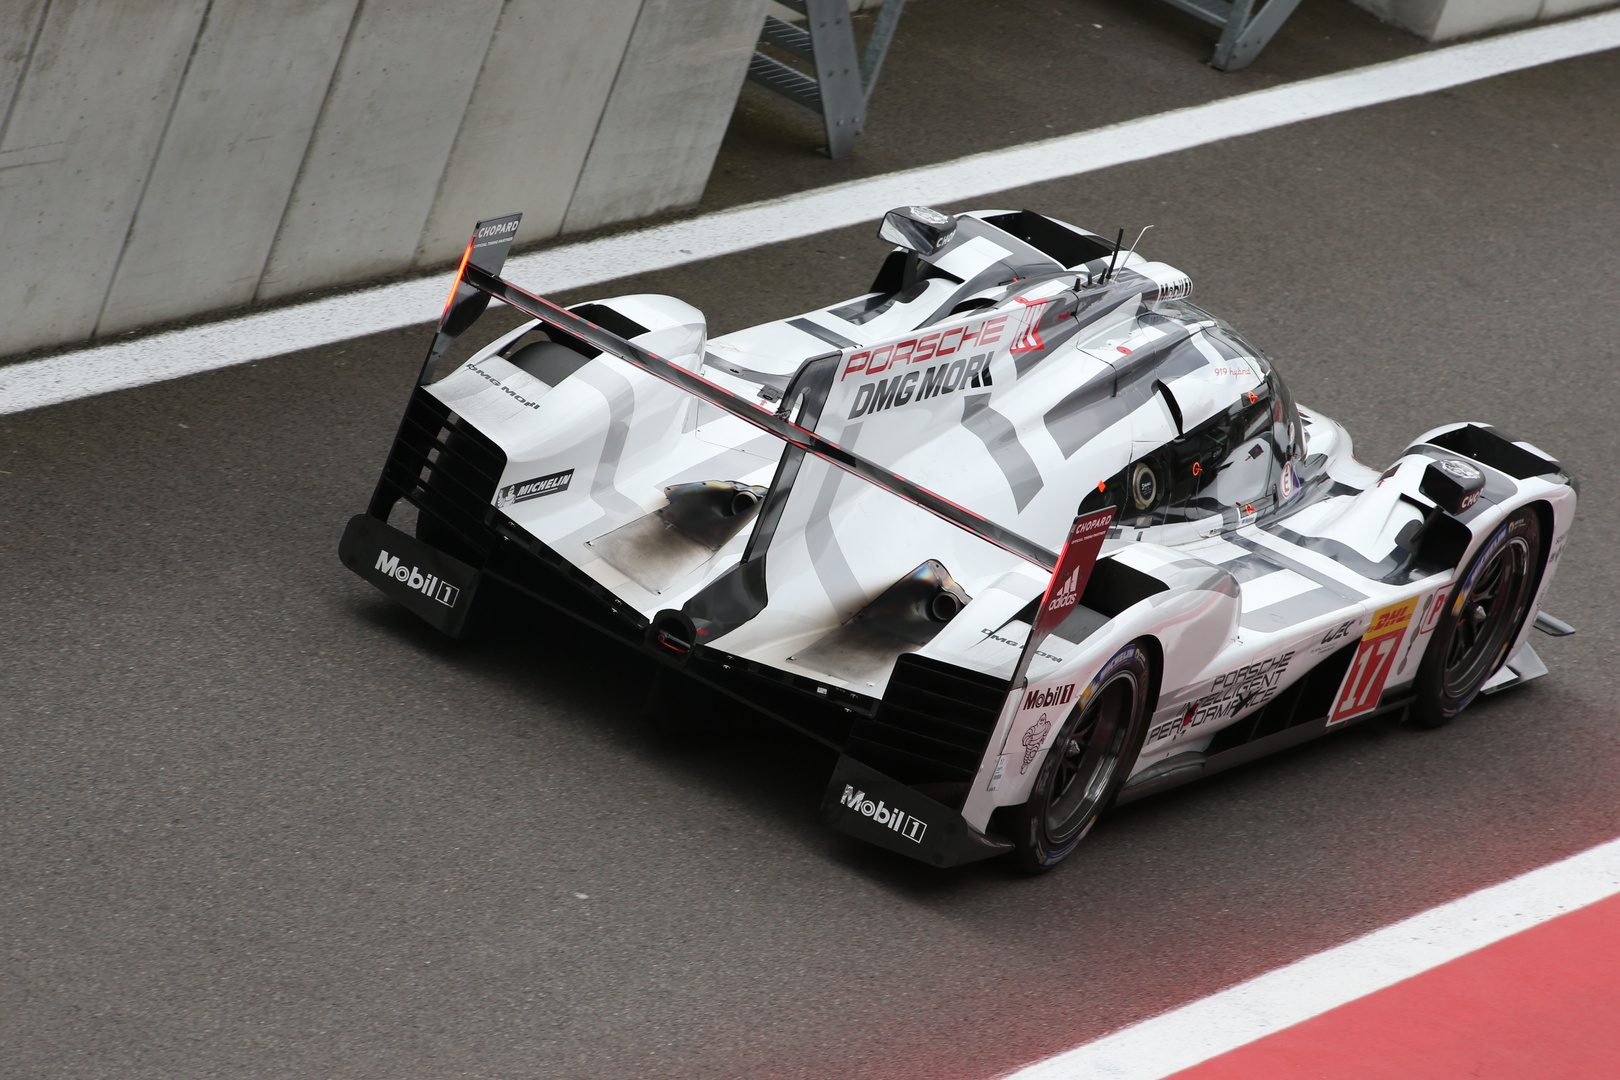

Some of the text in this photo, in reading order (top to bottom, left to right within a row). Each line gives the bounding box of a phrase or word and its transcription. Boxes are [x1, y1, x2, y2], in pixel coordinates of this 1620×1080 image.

[478, 220, 519, 238] CHOPARD
[1159, 280, 1184, 300] Mobil
[841, 316, 1009, 382] PORSCHE
[466, 363, 540, 410] DMG MORI
[848, 350, 995, 420] DMG MORI
[1214, 366, 1251, 381] 919 hybrid
[516, 473, 572, 497] MICHELIN
[1076, 515, 1112, 534] CHOPARD
[374, 549, 439, 598] Mobil
[1048, 592, 1077, 612] adidas
[1320, 619, 1356, 645] WEC
[1374, 605, 1410, 632] DHL
[980, 627, 1063, 664] DMG ORI
[1211, 650, 1296, 693] PORSCHE
[1338, 636, 1399, 714] 17
[1022, 685, 1063, 711] Mobil
[840, 783, 905, 833] Mobil
